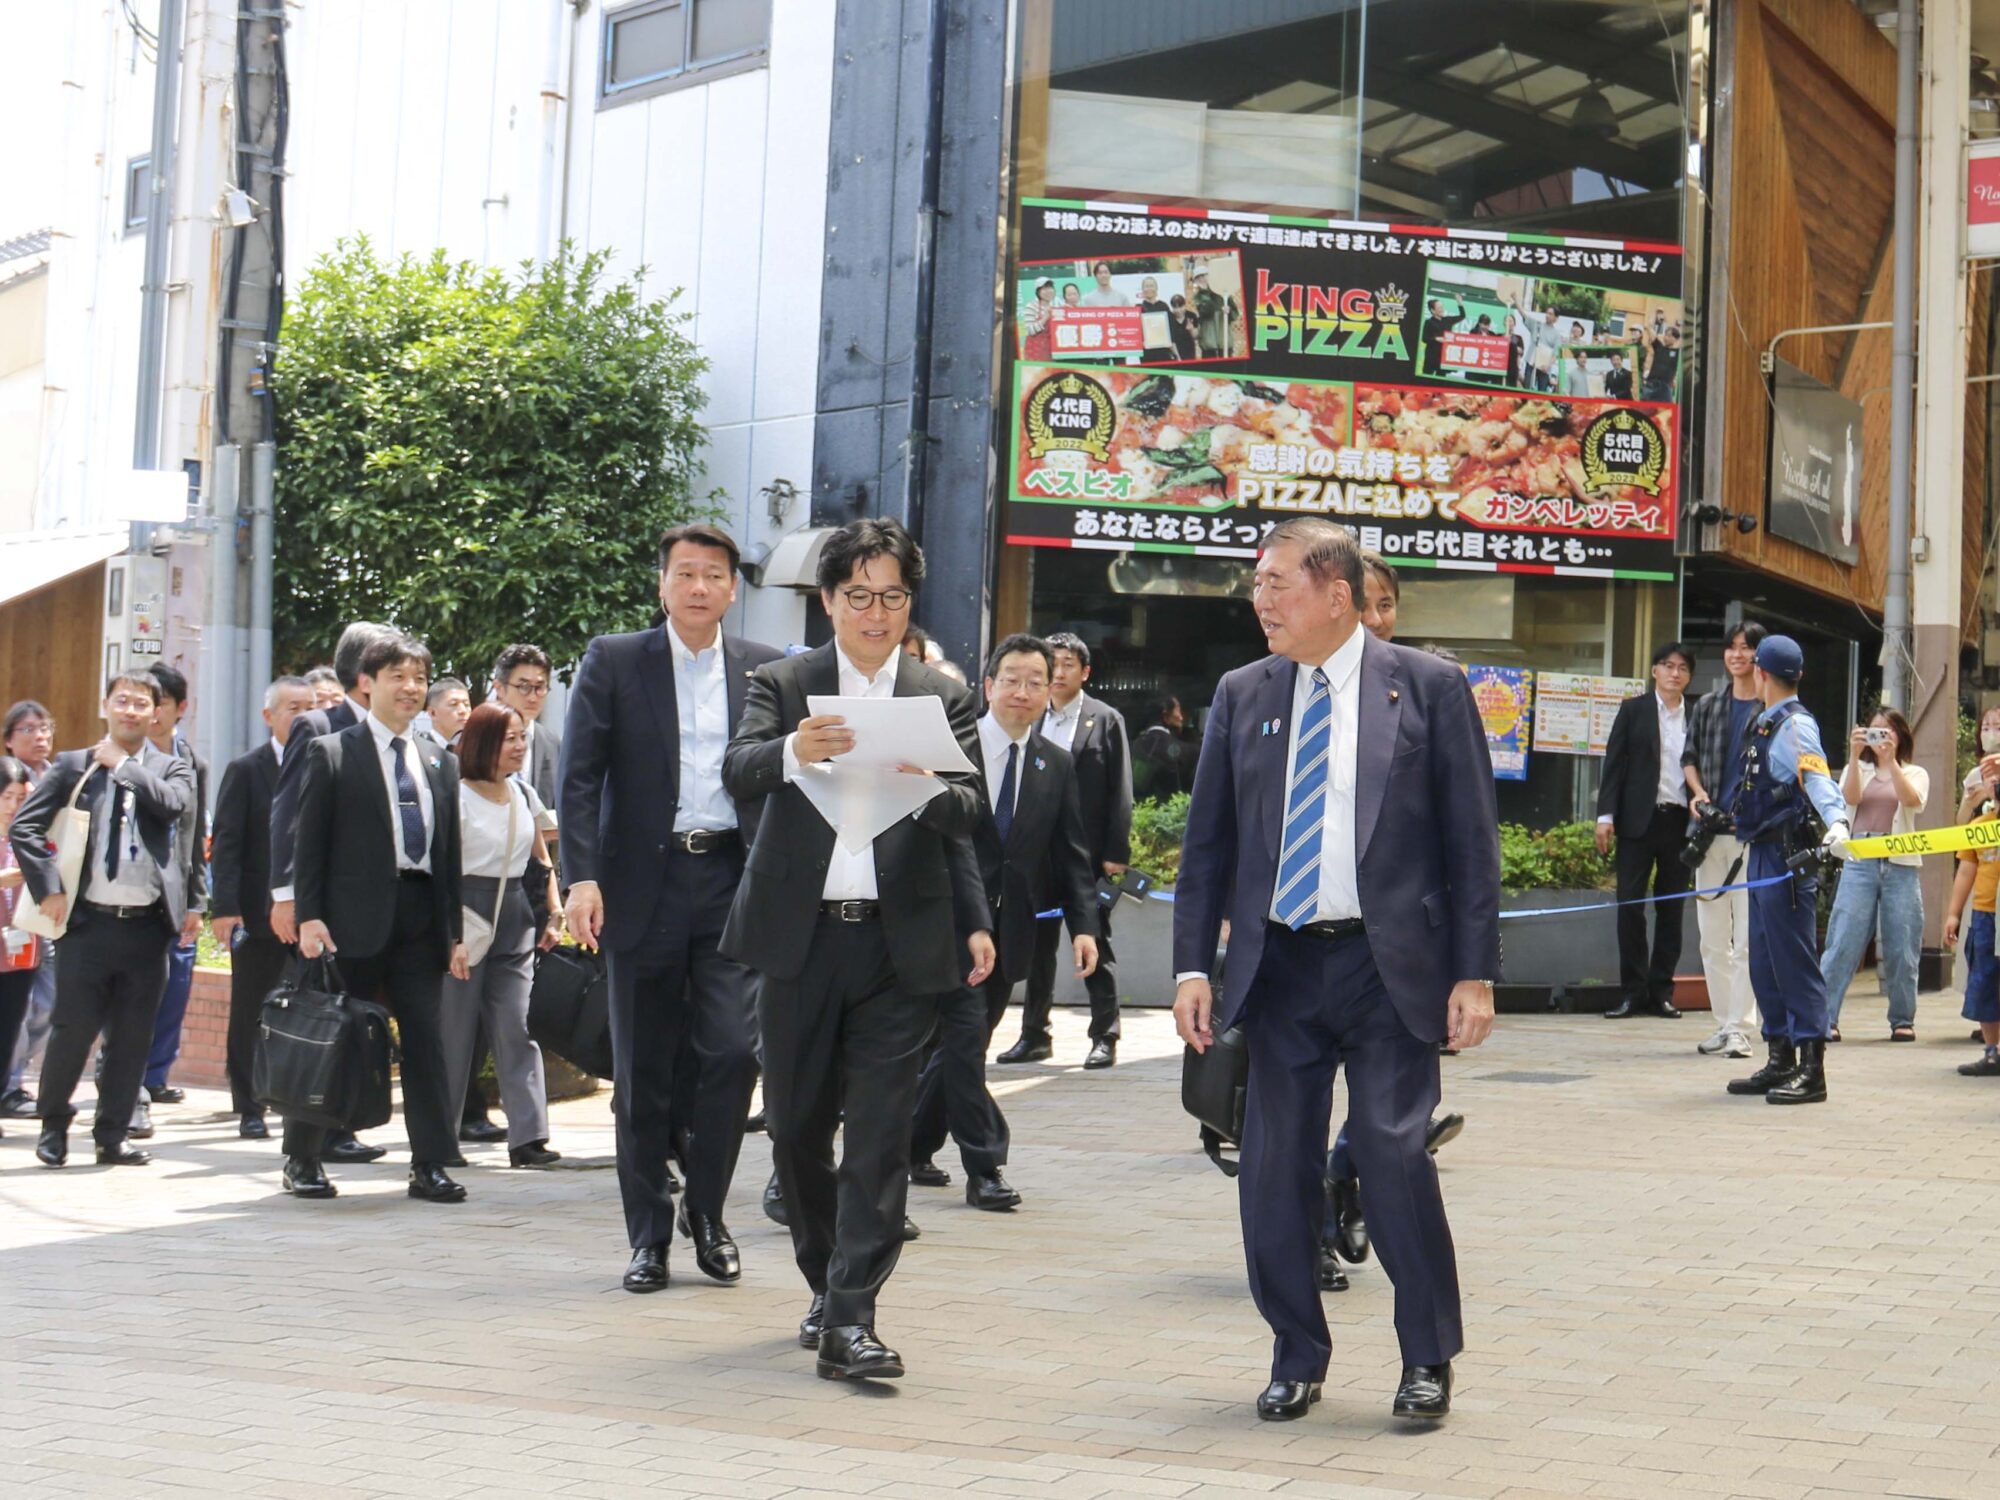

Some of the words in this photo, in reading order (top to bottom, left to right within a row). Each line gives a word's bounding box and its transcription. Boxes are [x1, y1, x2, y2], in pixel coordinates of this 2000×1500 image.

[1254, 268, 1375, 321] KING
[1376, 306, 1407, 323] OF
[1253, 314, 1410, 361] PIZZA
[1049, 397, 1092, 415] 4代目
[1048, 412, 1092, 428] KING
[1055, 438, 1084, 448] 2022
[1604, 432, 1644, 450] 5代目
[1249, 444, 1452, 483] 感謝の気持ちを
[1603, 449, 1643, 463] KING
[1026, 470, 1133, 498] ベスビオ
[1609, 474, 1636, 483] 2023
[1237, 478, 1460, 519] PIZZAに込めて
[1486, 495, 1659, 532] ガンベレッティ
[1885, 834, 1933, 854] POLICE
